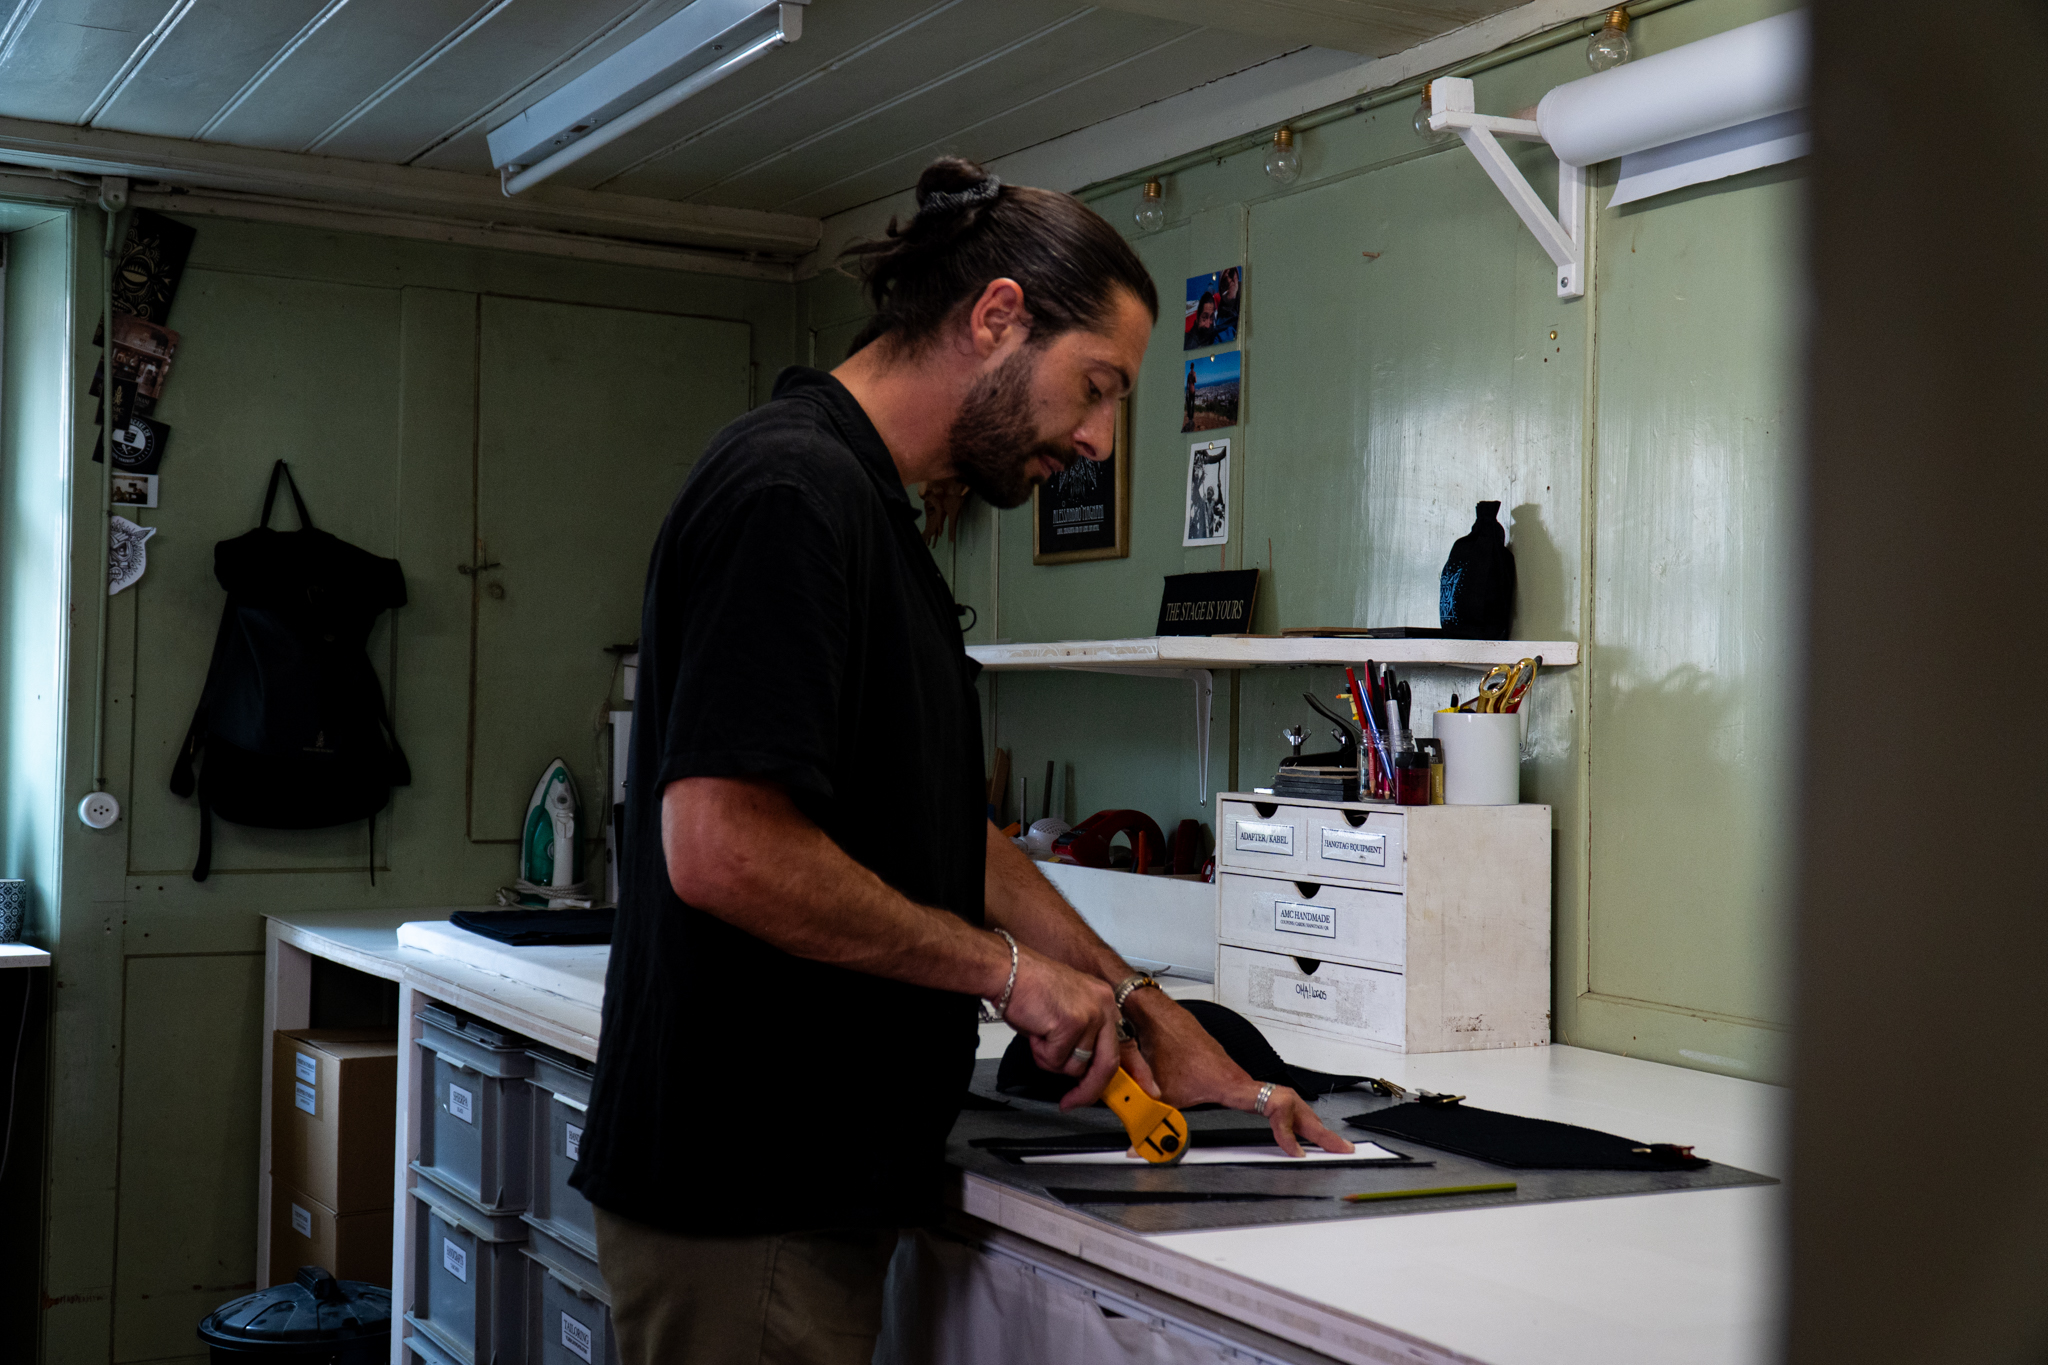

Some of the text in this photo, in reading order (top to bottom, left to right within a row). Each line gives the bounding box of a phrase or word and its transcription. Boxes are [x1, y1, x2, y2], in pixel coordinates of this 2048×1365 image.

[1165, 599, 1244, 622] THE STAGE IS YOURS
[1324, 839, 1383, 855] HANGTAG EQUIPMENT
[1280, 909, 1330, 924] AMC HANDMADE
[564, 1319, 589, 1345] TAILORING
